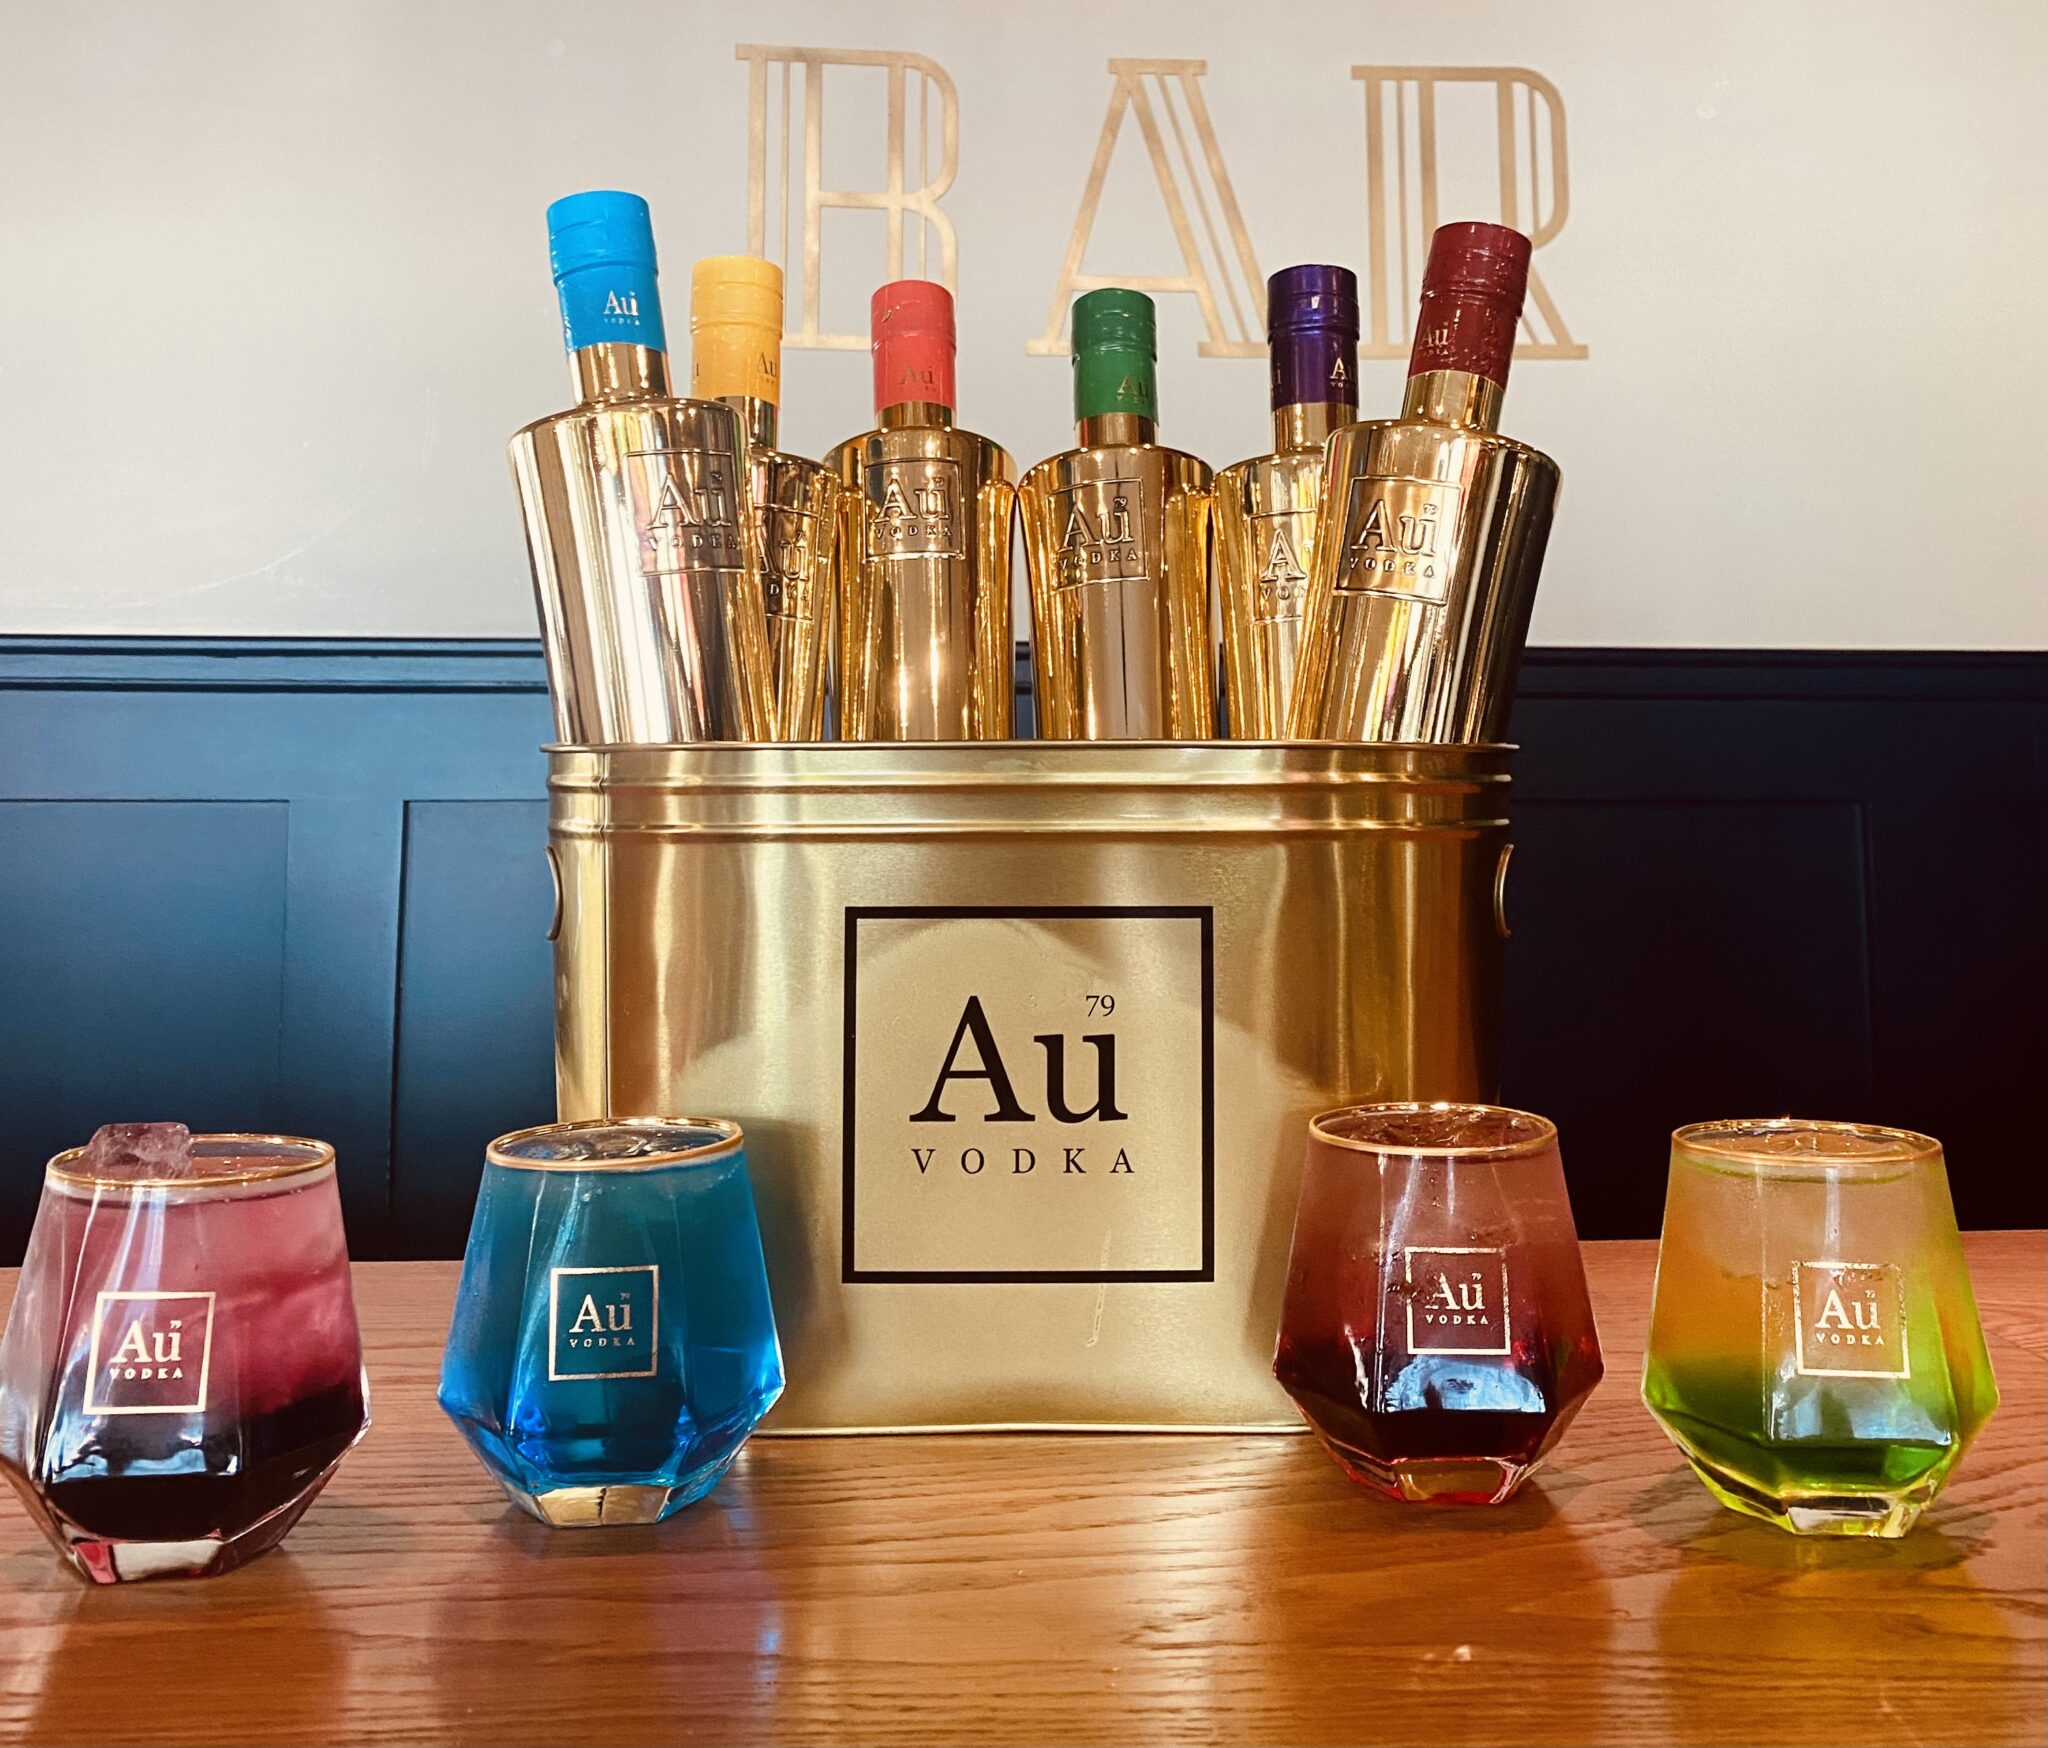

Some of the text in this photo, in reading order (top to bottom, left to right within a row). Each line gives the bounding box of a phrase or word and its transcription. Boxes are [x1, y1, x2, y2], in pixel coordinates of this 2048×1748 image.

[735, 43, 1589, 360] BAR
[646, 473, 732, 530] Au
[873, 478, 950, 523] Au
[875, 524, 953, 539] VODKA
[1057, 502, 1135, 553] Au
[1350, 499, 1437, 557] Au
[1350, 557, 1435, 579] VODKA
[1085, 995, 1115, 1018] 79
[909, 995, 1129, 1124] Au
[911, 1148, 1135, 1175] VODKA
[1425, 1272, 1486, 1311] Au
[1814, 1288, 1881, 1330] Au
[568, 1293, 633, 1334] Au
[1425, 1314, 1489, 1325] VODKA
[109, 1319, 182, 1363] Au
[569, 1337, 635, 1348] VODKA
[1815, 1332, 1885, 1346] VODKA
[109, 1367, 184, 1380] VODKA
